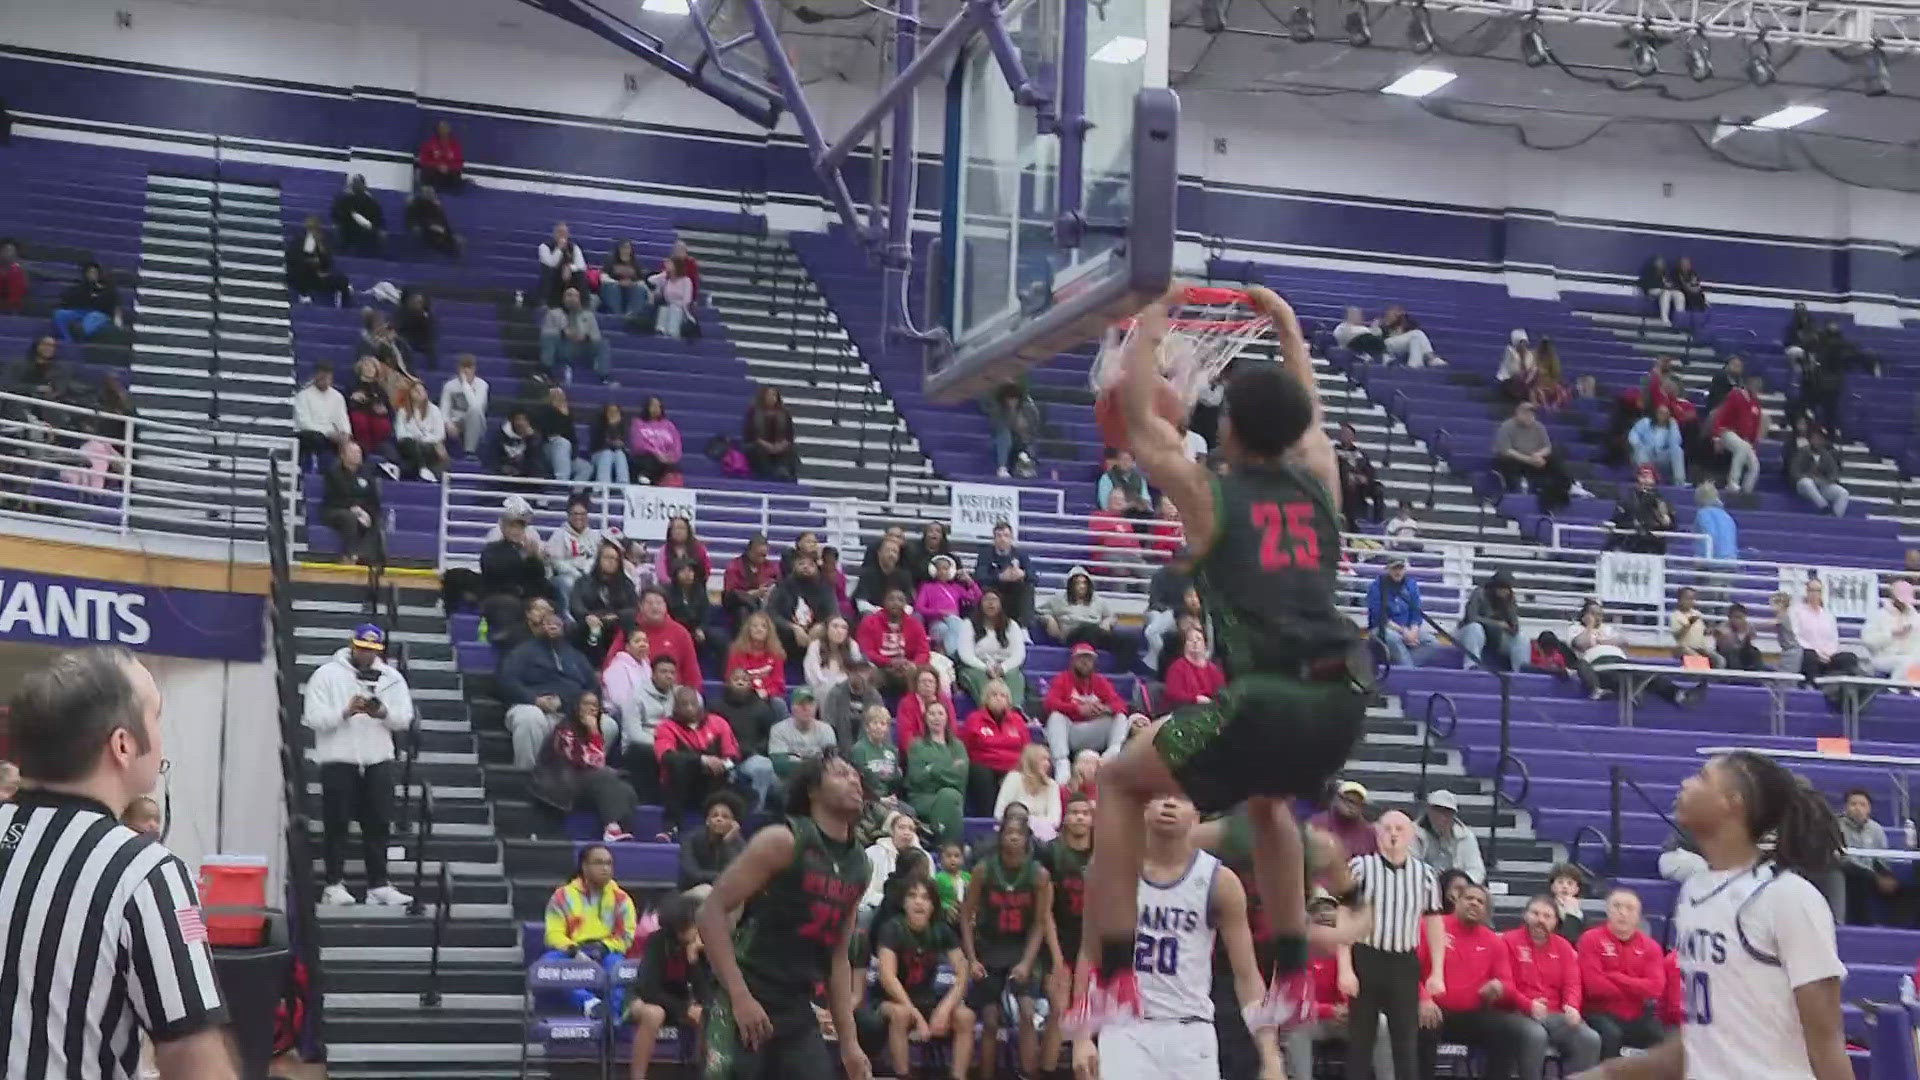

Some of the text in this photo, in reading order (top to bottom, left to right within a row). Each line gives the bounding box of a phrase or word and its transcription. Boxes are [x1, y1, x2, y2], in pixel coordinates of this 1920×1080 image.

[1251, 501, 1320, 570] 25
[0, 580, 151, 645] ANTS
[1140, 903, 1199, 933] ANTS
[1135, 932, 1179, 976] 20
